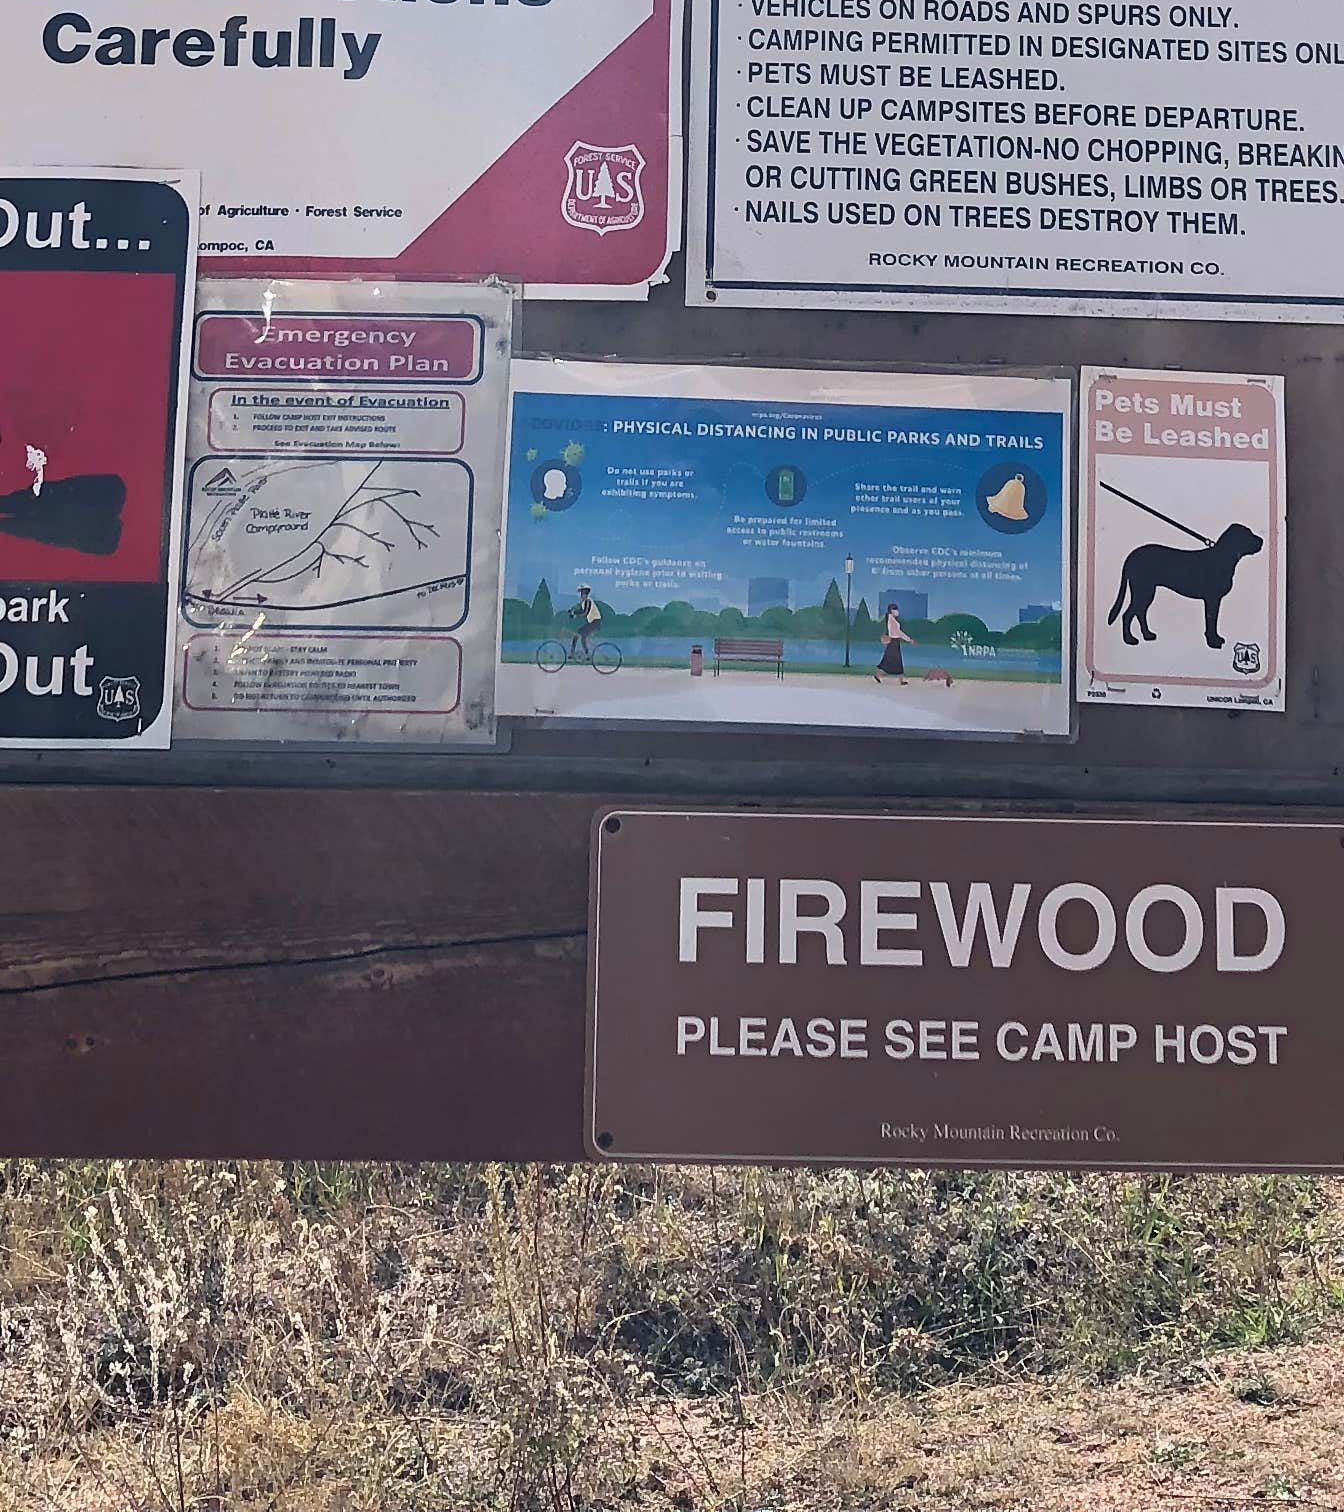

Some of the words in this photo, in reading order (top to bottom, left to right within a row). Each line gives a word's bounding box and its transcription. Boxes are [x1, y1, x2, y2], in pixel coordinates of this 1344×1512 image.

[42, 12, 382, 79] Carefully
[748, 28, 862, 52] CAMPING
[872, 31, 1010, 55] PERMITTED
[1019, 35, 1042, 56] IN
[1052, 36, 1209, 60] DESIGNATED
[1218, 40, 1287, 63] SITES
[217, 204, 289, 218] Agriculture
[306, 205, 347, 217] Forest
[354, 206, 402, 218] Service
[869, 253, 937, 266] ROCKY
[944, 255, 1048, 270] MOUNTAIN
[1056, 258, 1183, 274] RECREATION
[1190, 261, 1224, 275] CO.
[259, 324, 416, 347] Emergency
[225, 353, 378, 370] Evacuation
[389, 354, 448, 371] Plan
[231, 394, 248, 405] In
[251, 394, 280, 405] the
[286, 396, 334, 405] event
[340, 395, 355, 405] of
[359, 396, 449, 407] Evacuation
[1095, 389, 1160, 414] Pets
[1170, 393, 1242, 419] Must
[613, 420, 692, 435] PHYSICAL
[697, 423, 795, 439] DISTANCING
[802, 427, 817, 440] IN
[824, 428, 881, 442] PUBLIC
[887, 430, 939, 445] PARKS
[945, 433, 980, 446] AND
[985, 434, 1043, 449] TRAILS
[1095, 420, 1133, 443] Be
[1144, 423, 1269, 450] Leashed
[968, 645, 996, 657] NRPA
[679, 877, 1285, 972] FIREWOOD
[677, 1016, 868, 1058] PLEASE
[884, 1019, 979, 1059] SEE
[996, 1021, 1137, 1061] CAMP
[1155, 1024, 1287, 1064] HOST
[881, 1122, 925, 1142] Rocky
[934, 1123, 1004, 1139] Mountain
[1010, 1125, 1088, 1141] Recreation
[1093, 1127, 1119, 1141] Co.
